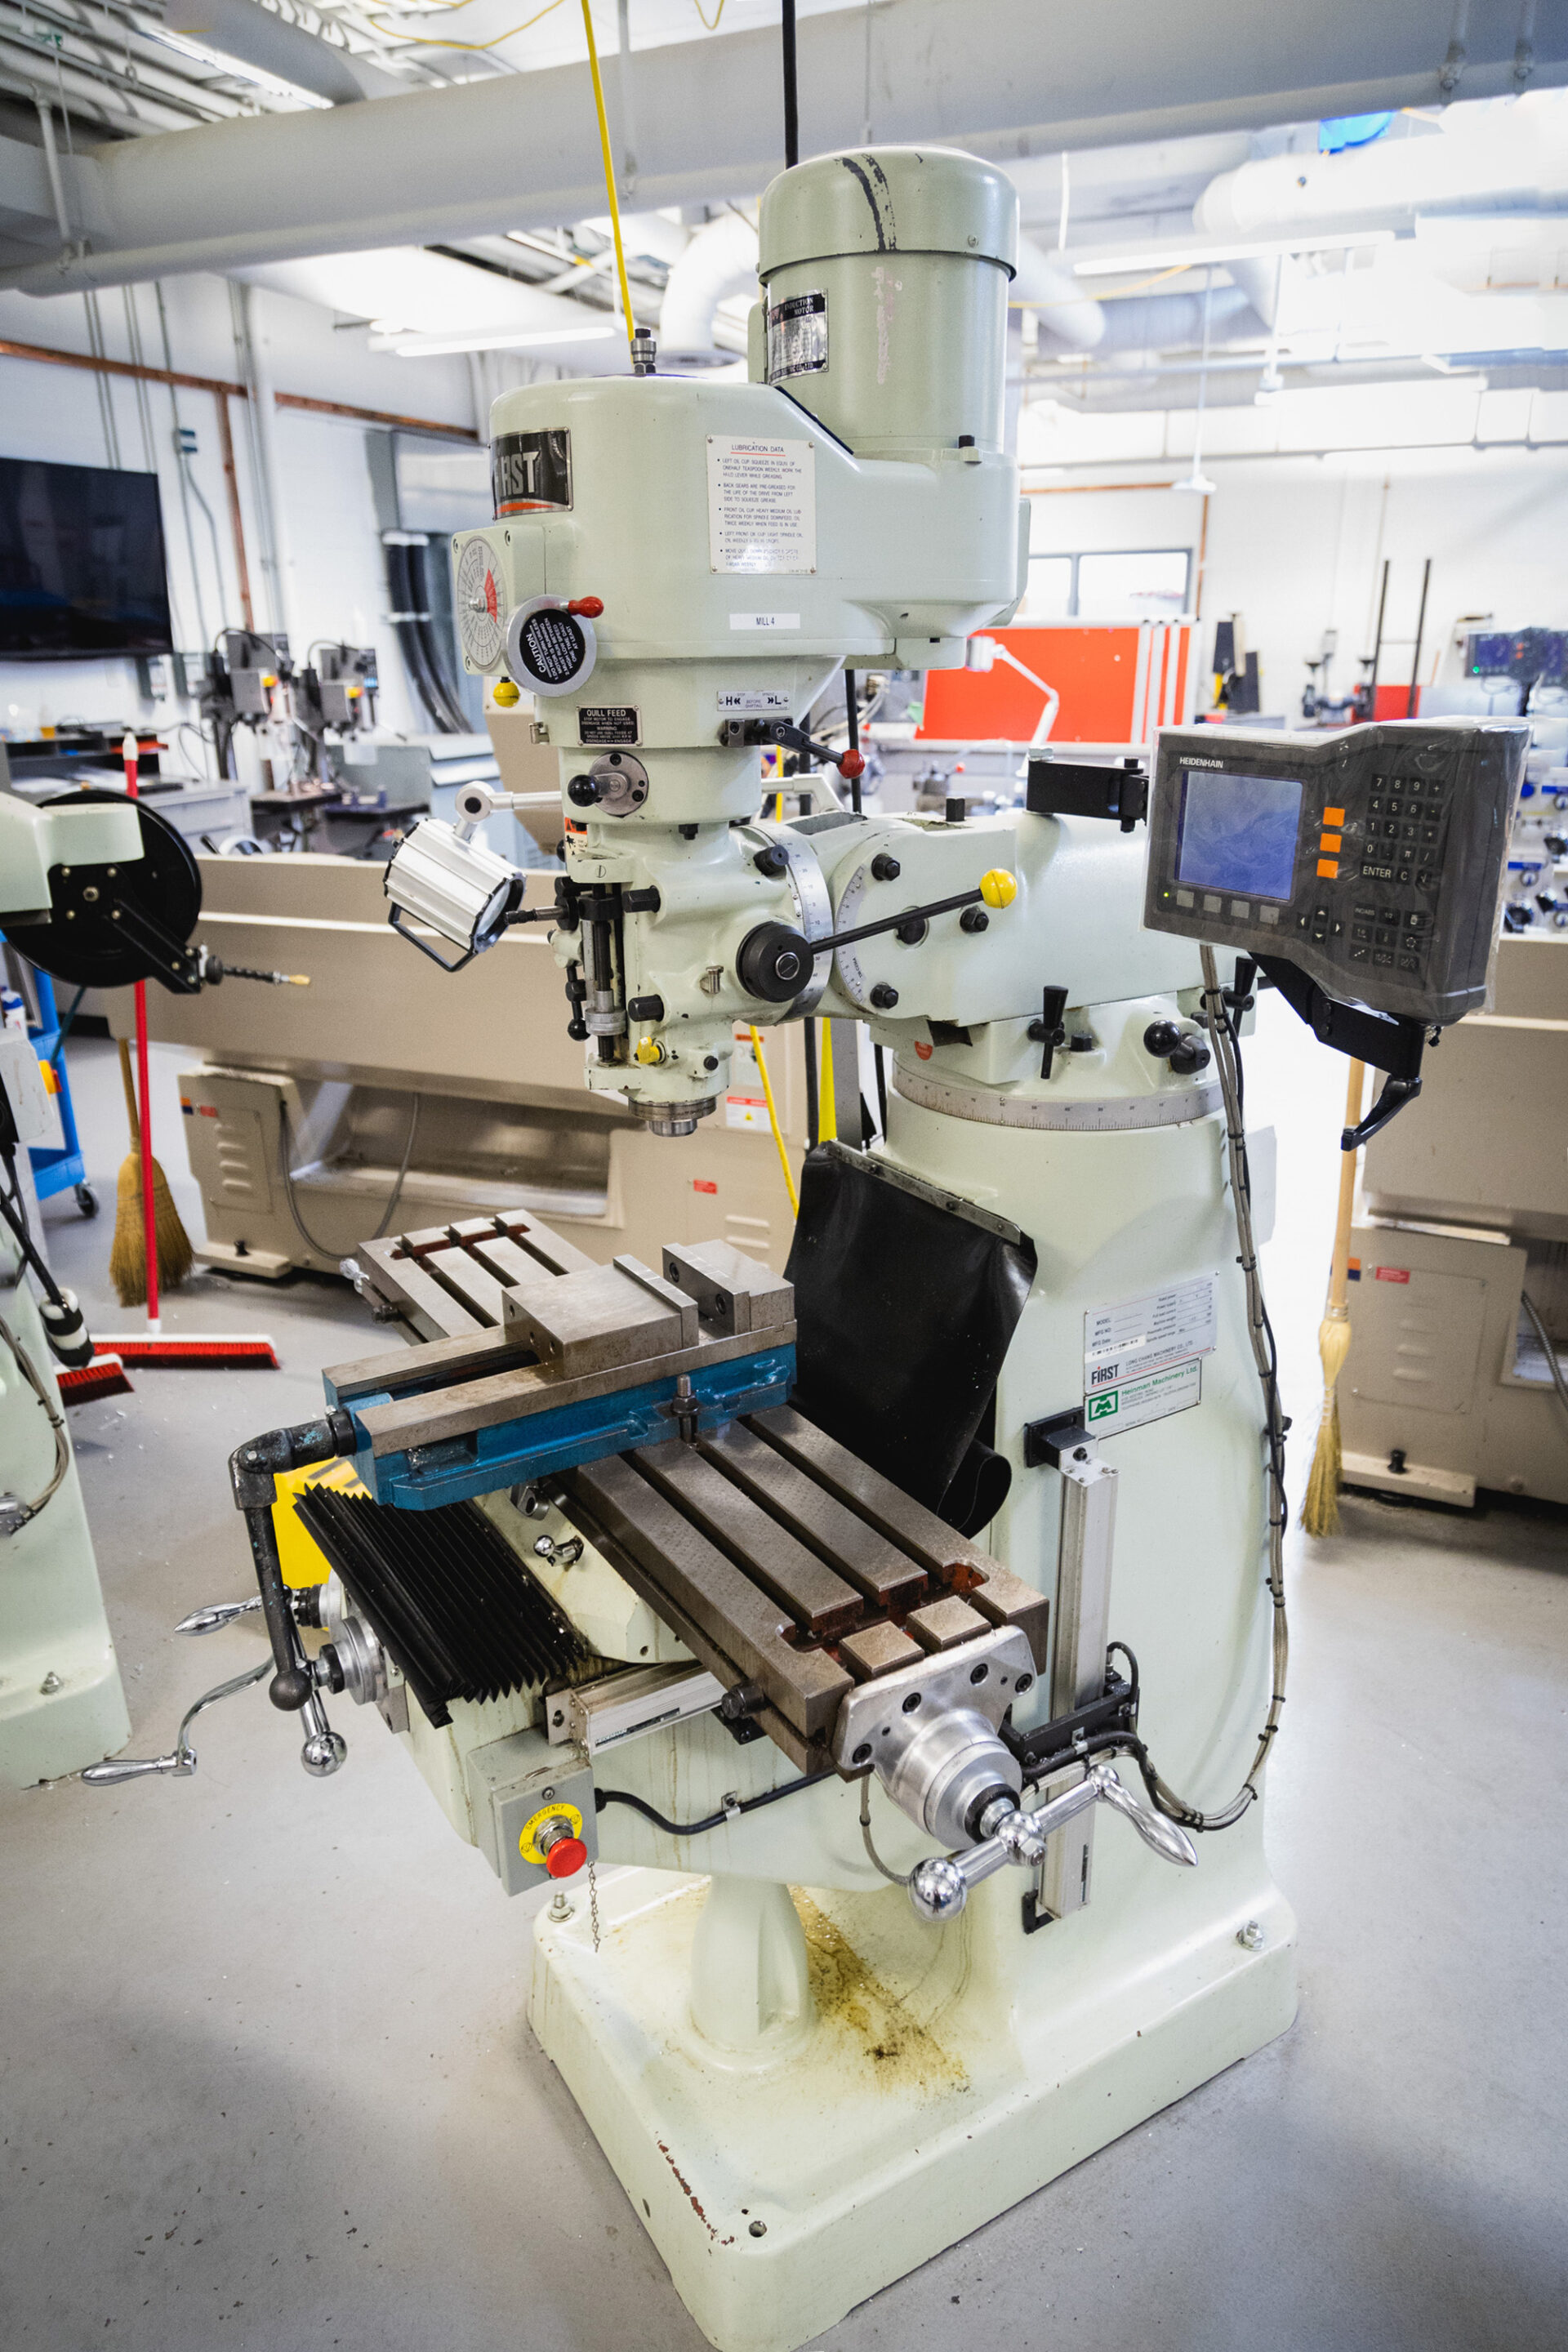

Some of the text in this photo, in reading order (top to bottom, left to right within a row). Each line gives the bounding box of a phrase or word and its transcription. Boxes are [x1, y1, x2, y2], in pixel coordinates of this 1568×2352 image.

[731, 443, 768, 452] LUBRICATION
[755, 617, 775, 626] MILL 4
[539, 622, 552, 648] RUNNING
[543, 617, 558, 644] BETWEEN
[552, 624, 564, 643] SPEED
[565, 626, 579, 650] AT LEAST
[526, 633, 546, 673] CAUTION
[540, 639, 549, 656] TURN
[559, 642, 568, 657] LOW
[546, 655, 554, 668] NOT
[551, 653, 563, 675] MOTOR
[586, 709, 626, 717] QUILL FEED
[1179, 756, 1223, 768] HEIDENHAIN
[1376, 777, 1383, 787] 7
[1394, 779, 1401, 789] 8
[1413, 781, 1420, 791] 9
[1372, 800, 1417, 813] 4 5 6
[1371, 822, 1414, 836] 1 2 3
[1366, 844, 1373, 853] 0
[1362, 865, 1408, 881] ENTER C
[1126, 1356, 1139, 1366] LONG
[1153, 1346, 1177, 1359] MACHINERY
[1121, 1381, 1151, 1396] Heinman
[1152, 1370, 1184, 1389] Machinery
[526, 1804, 565, 1830] EMERGENCY
